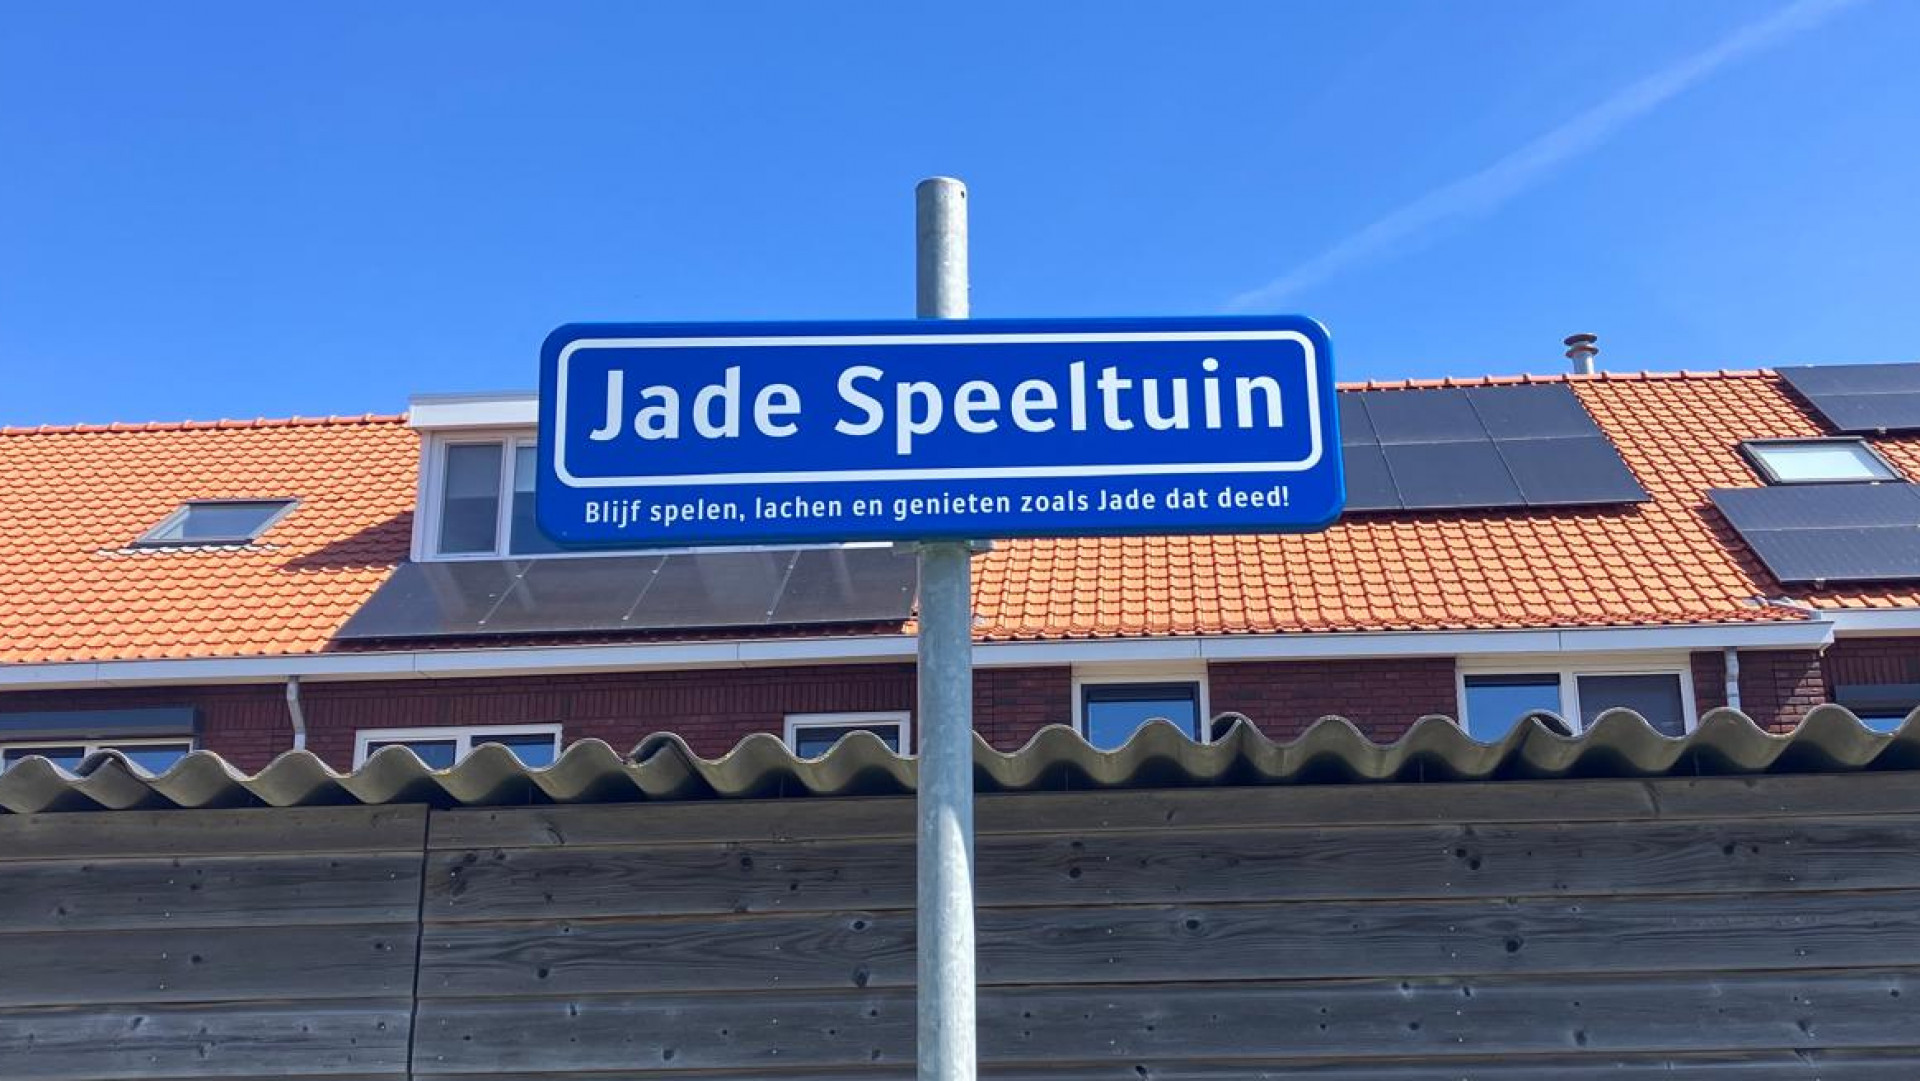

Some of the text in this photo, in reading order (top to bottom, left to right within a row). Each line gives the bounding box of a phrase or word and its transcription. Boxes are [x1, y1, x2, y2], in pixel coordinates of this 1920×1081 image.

[590, 357, 1283, 455] Jade Speeltuin
[585, 485, 1290, 528] Blijf spelen, lachen en genieten zoals Jade dat deed!
